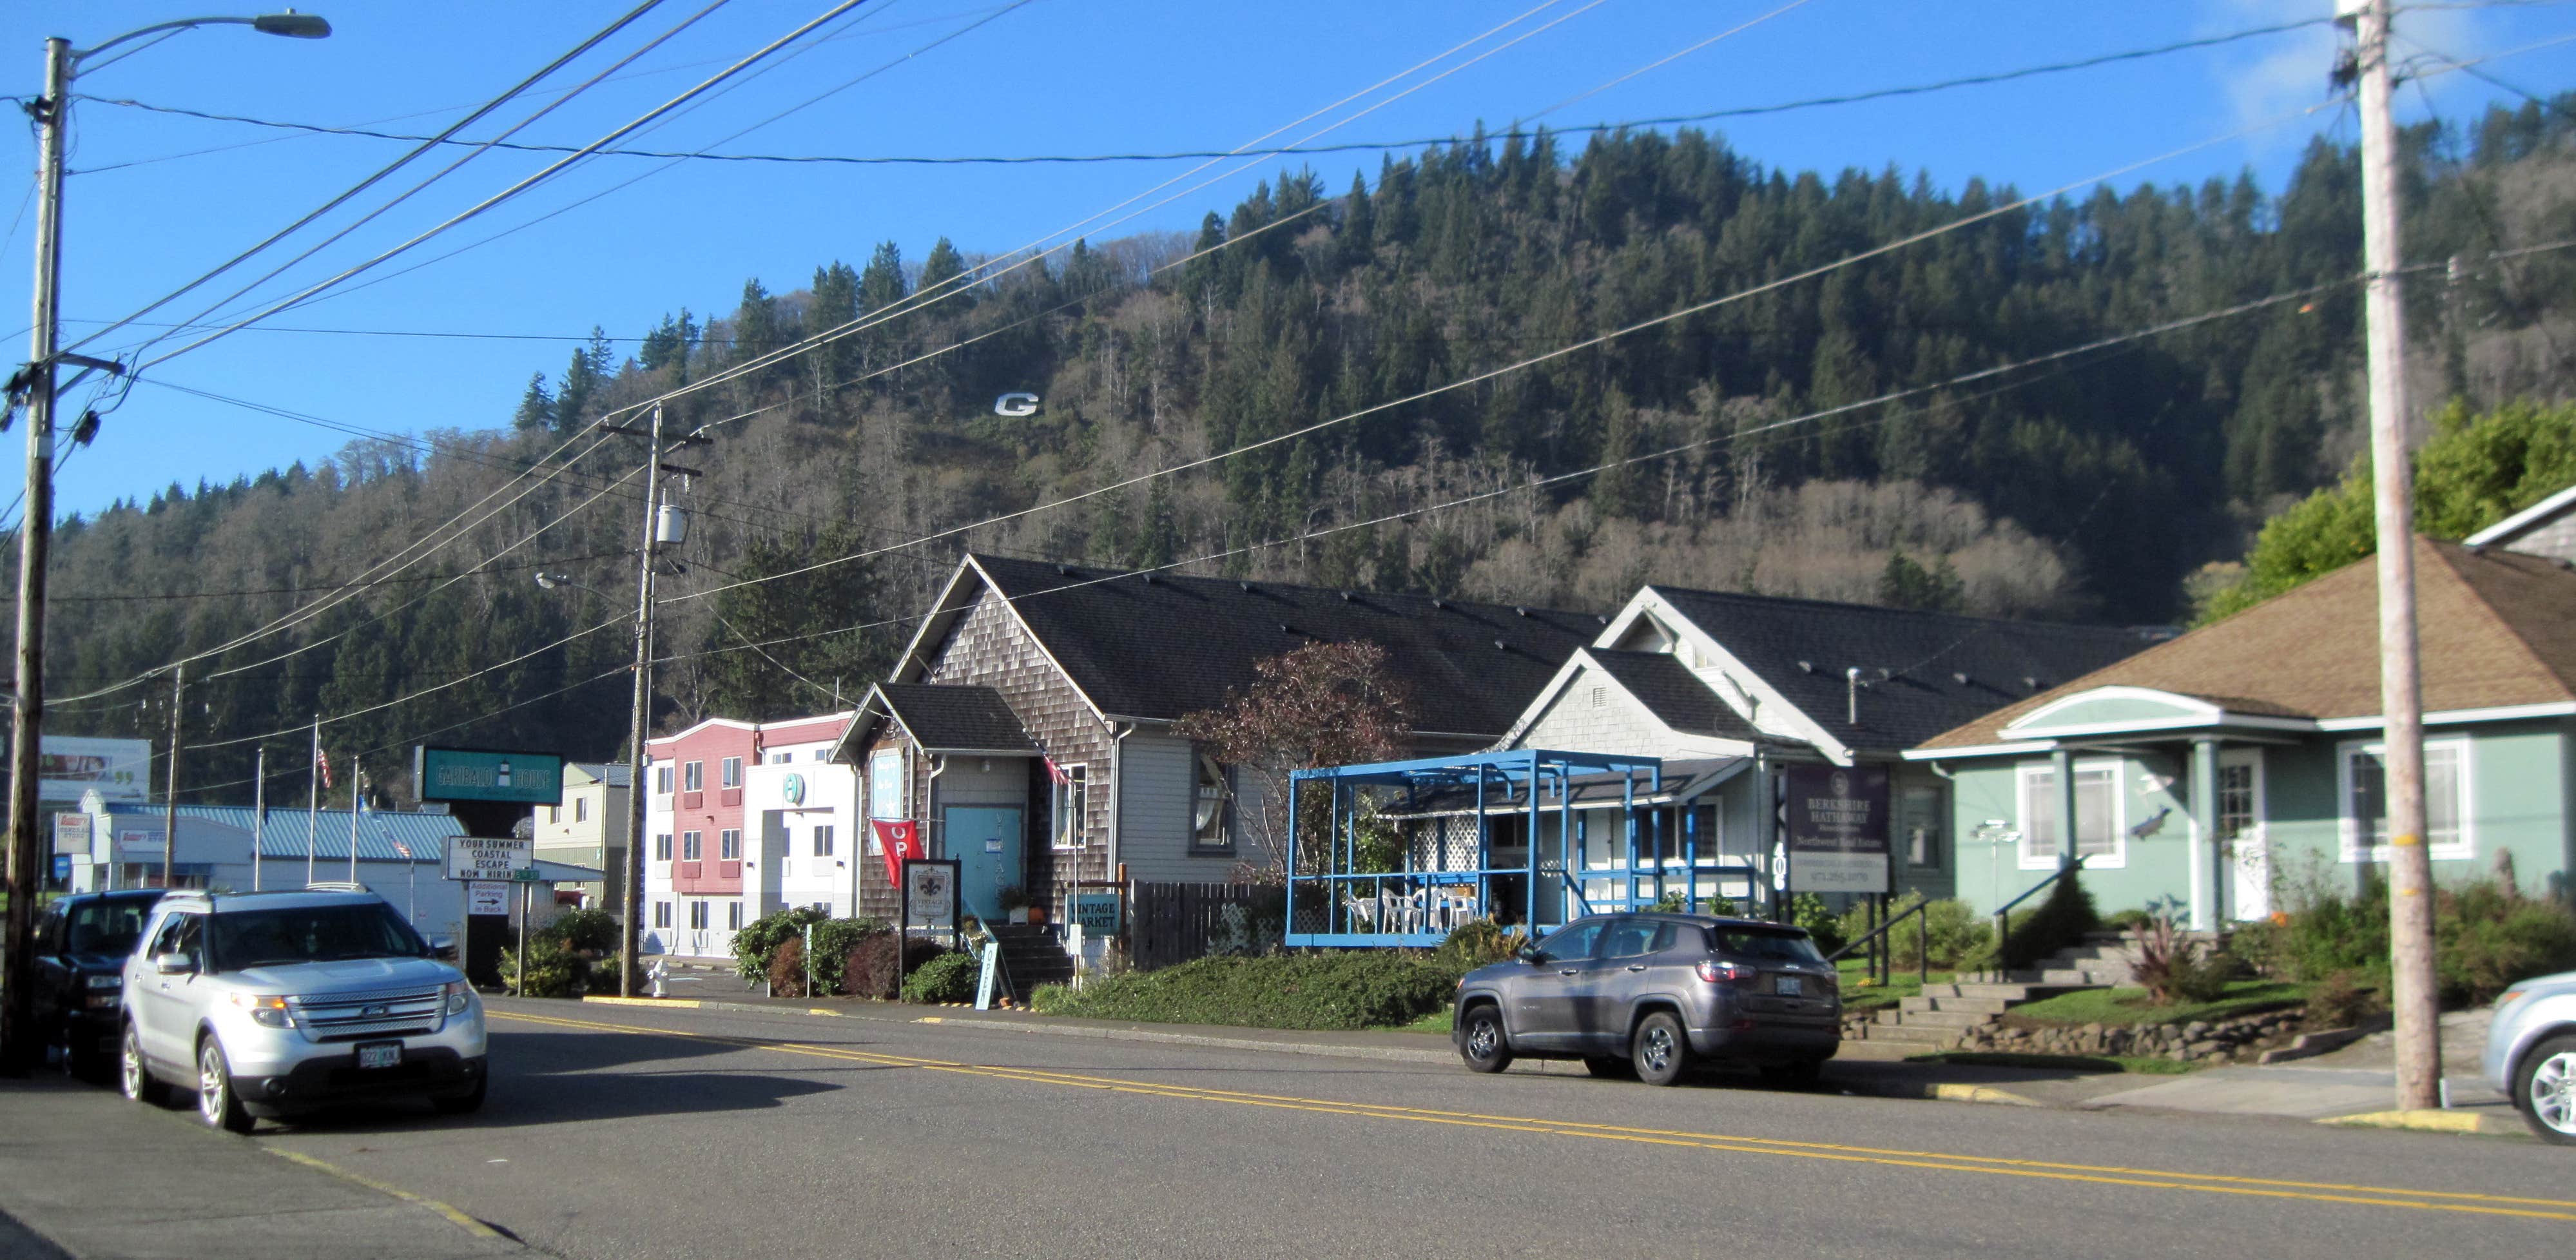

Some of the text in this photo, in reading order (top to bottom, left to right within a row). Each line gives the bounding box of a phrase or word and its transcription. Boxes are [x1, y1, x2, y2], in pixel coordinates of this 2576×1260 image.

[994, 393, 1039, 416] G
[437, 764, 551, 790] GARIBALDI HOUSE
[1807, 798, 1871, 811] BERKSHIRE
[1810, 811, 1868, 824] HATHAWAY
[460, 840, 525, 849] YOUR SUMMER
[472, 850, 512, 859] COASTAL
[476, 860, 509, 869] ESCAPE
[1772, 841, 1787, 891] 406
[487, 870, 512, 879] HIRIN
[475, 890, 503, 898] Parking
[1070, 903, 1115, 914] VINTAGE
[980, 949, 993, 1002] OPEN
